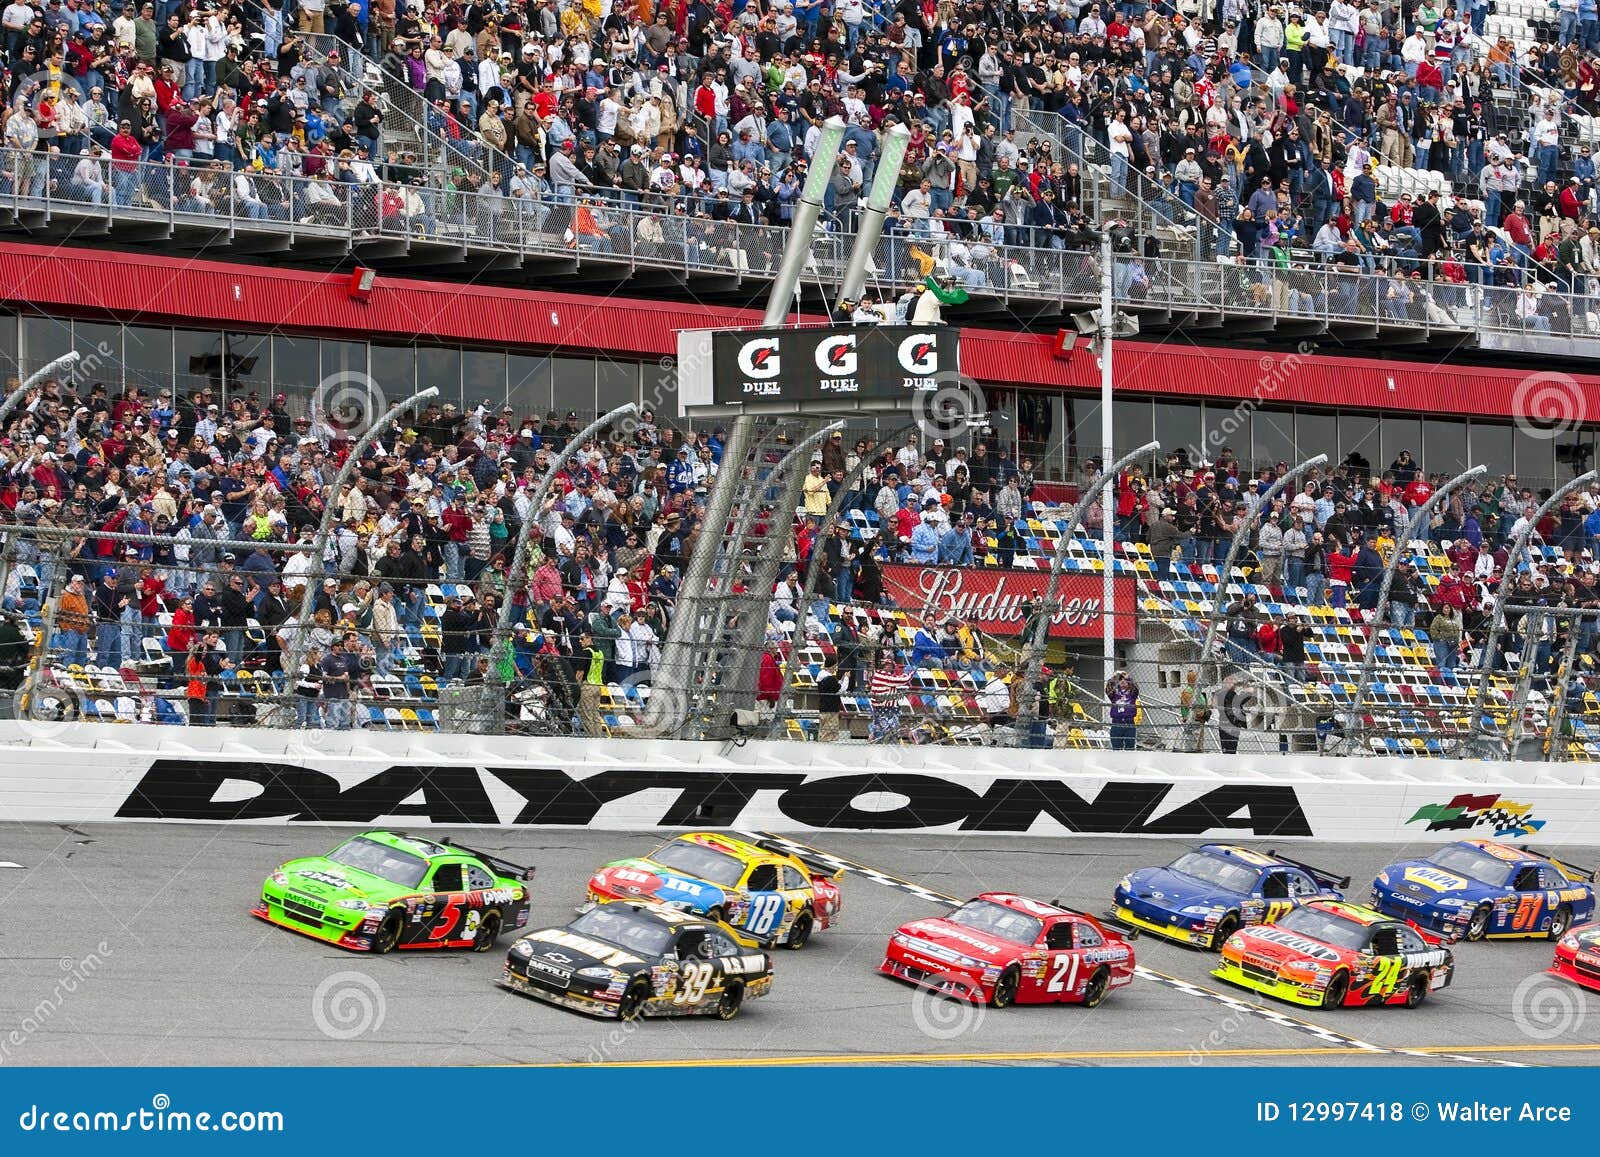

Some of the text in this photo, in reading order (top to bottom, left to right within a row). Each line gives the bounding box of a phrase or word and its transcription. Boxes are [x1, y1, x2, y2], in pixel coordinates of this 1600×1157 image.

[742, 381, 781, 393] DUEL
[820, 379, 859, 390] DUEL
[903, 377, 938, 388] DUEL
[919, 568, 1100, 627] Budwser
[113, 759, 1314, 837] DAYTONA
[1411, 869, 1460, 888] NAPA
[283, 892, 326, 911] IMPALA
[1391, 892, 1426, 907] CAMRY
[1512, 893, 1544, 930] 51
[428, 893, 466, 940] 5
[747, 895, 782, 934] 18
[528, 959, 572, 980] IMPALA
[903, 952, 951, 973] FUSION
[1047, 954, 1080, 993] 21
[1368, 956, 1403, 994] 24
[672, 963, 714, 1006] 39
